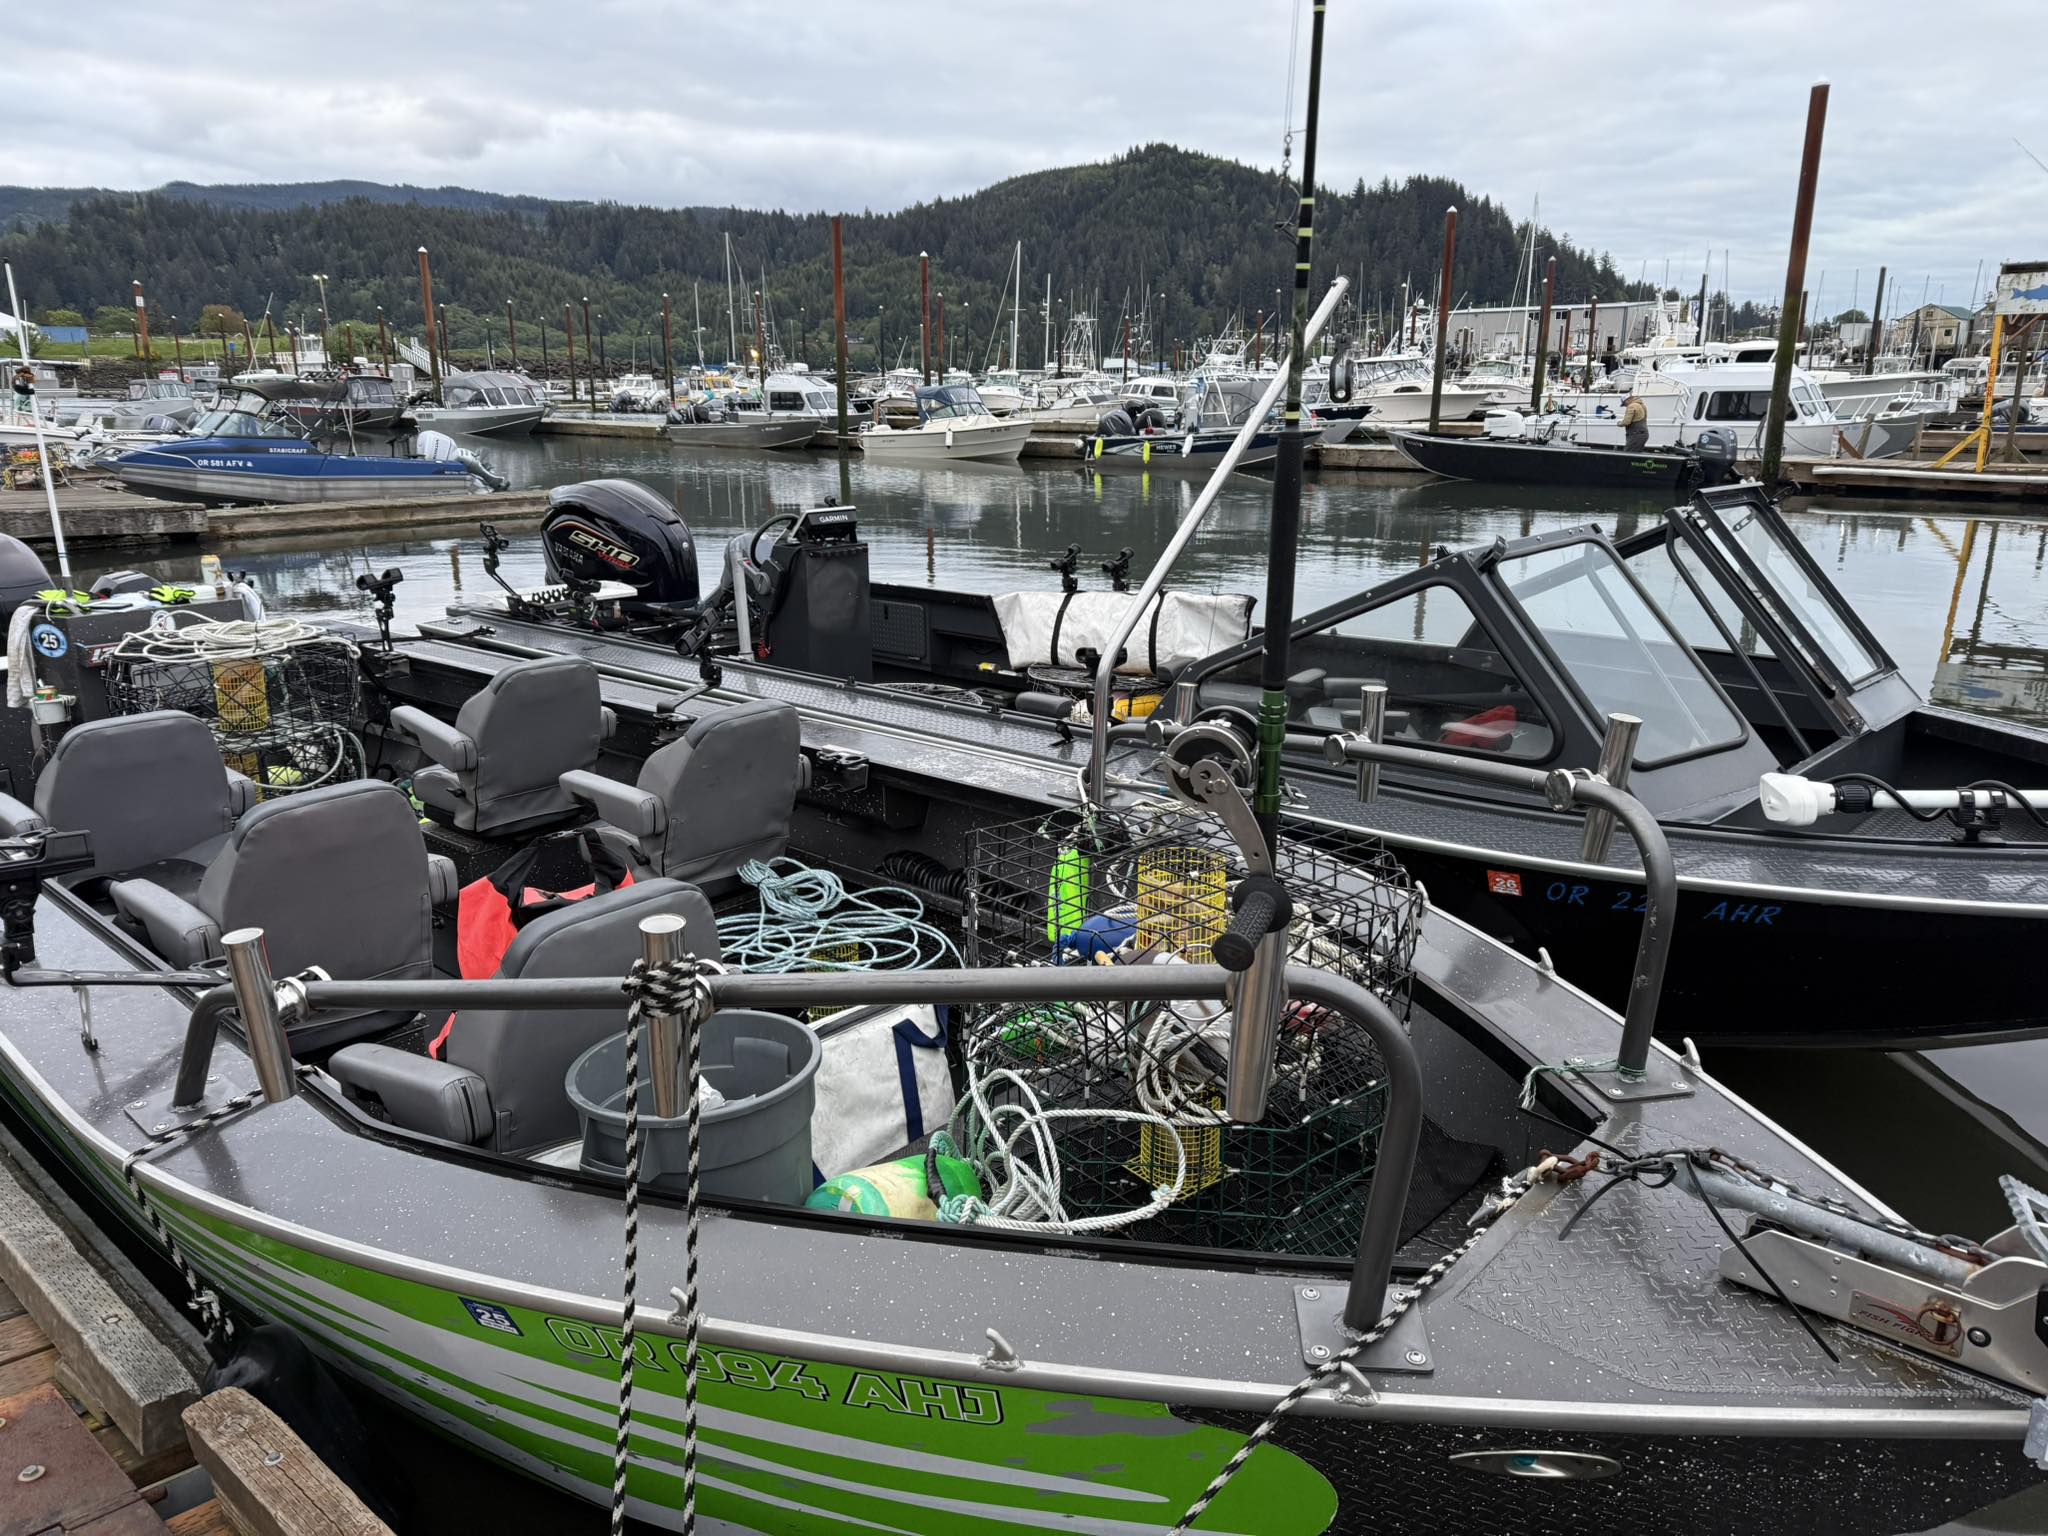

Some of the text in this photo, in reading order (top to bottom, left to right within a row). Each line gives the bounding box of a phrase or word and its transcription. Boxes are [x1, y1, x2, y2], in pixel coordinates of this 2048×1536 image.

[197, 459, 209, 467] OR
[818, 514, 849, 523] GARMIN
[568, 530, 640, 567] SHO
[40, 633, 59, 649] 25
[1546, 882, 1590, 906] OR
[1704, 901, 1783, 926] AHR
[475, 1308, 511, 1327] 25
[545, 1317, 1005, 1426] OR 994 AHJ
